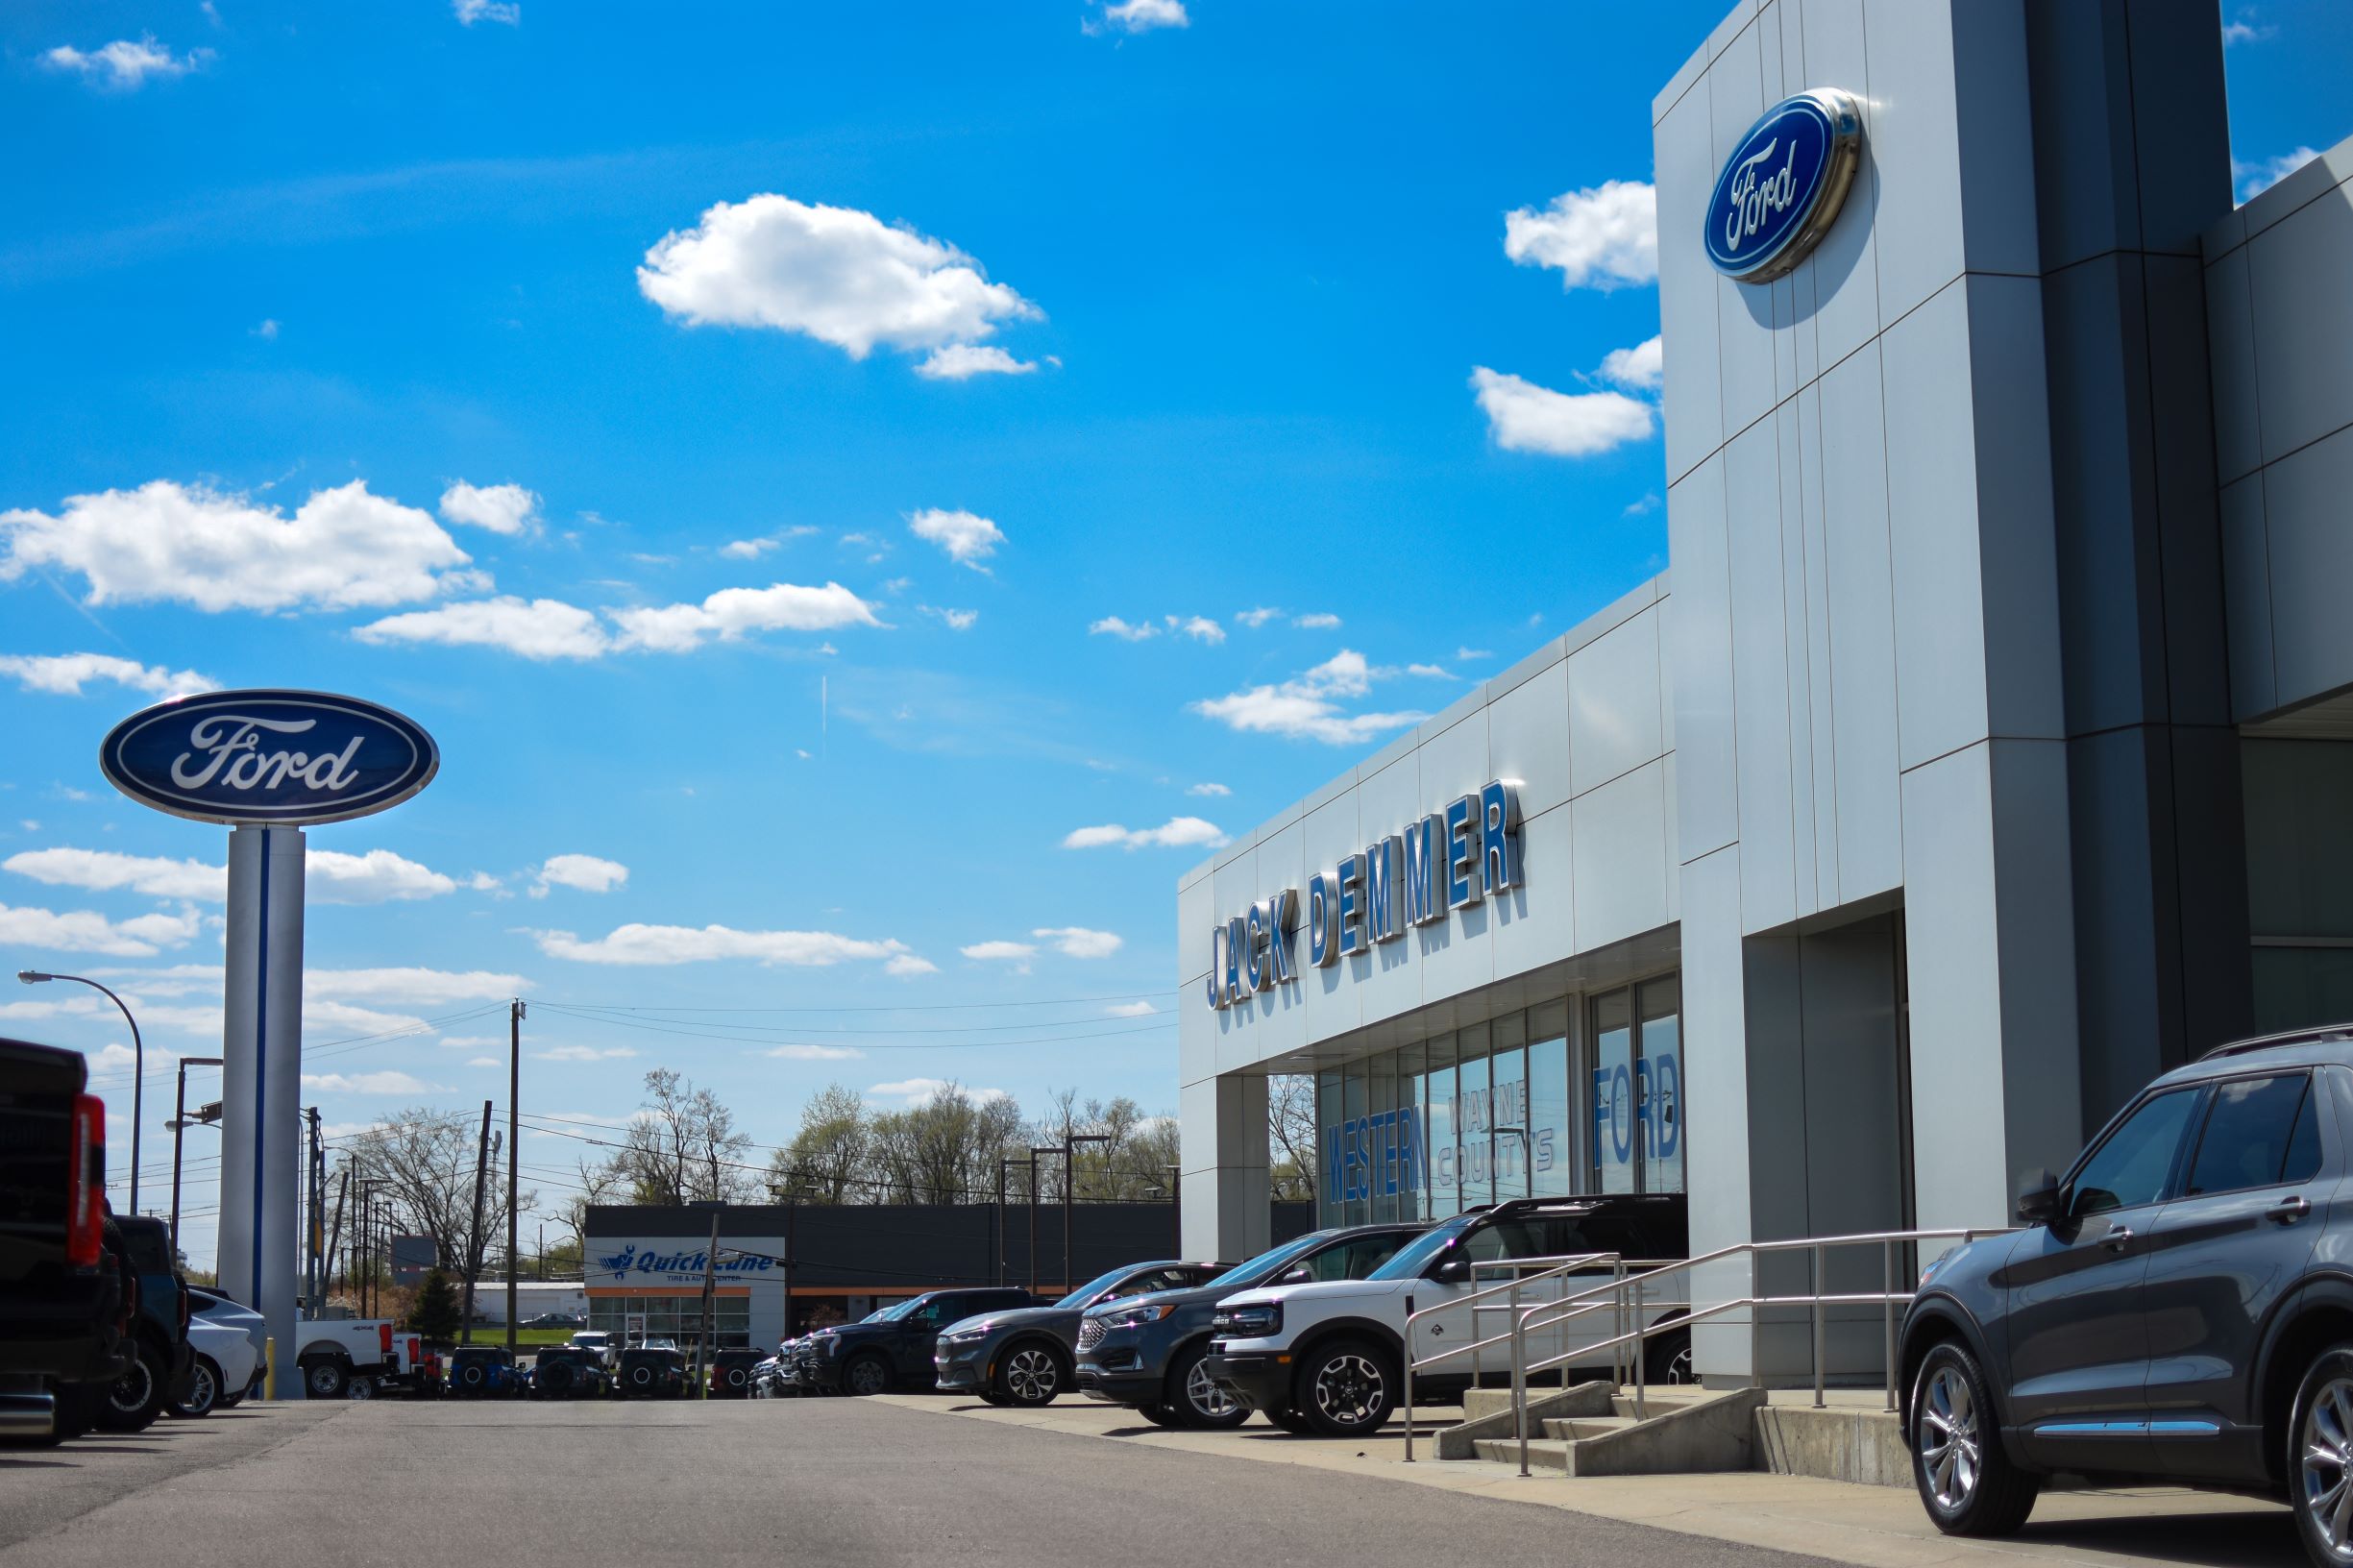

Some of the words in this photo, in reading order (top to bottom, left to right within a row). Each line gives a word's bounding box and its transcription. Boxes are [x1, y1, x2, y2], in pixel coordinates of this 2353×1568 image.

[1726, 137, 1798, 252] Ford
[171, 715, 365, 791] Ford
[1207, 889, 1298, 1011] JACK
[1309, 779, 1521, 968] DEMMER
[1448, 1079, 1527, 1136] WAYNE
[1594, 1054, 1680, 1170] FORD
[1327, 1105, 1427, 1204] WESTERN
[1437, 1128, 1554, 1186] COUNTY'S
[637, 1251, 709, 1273] Quick
